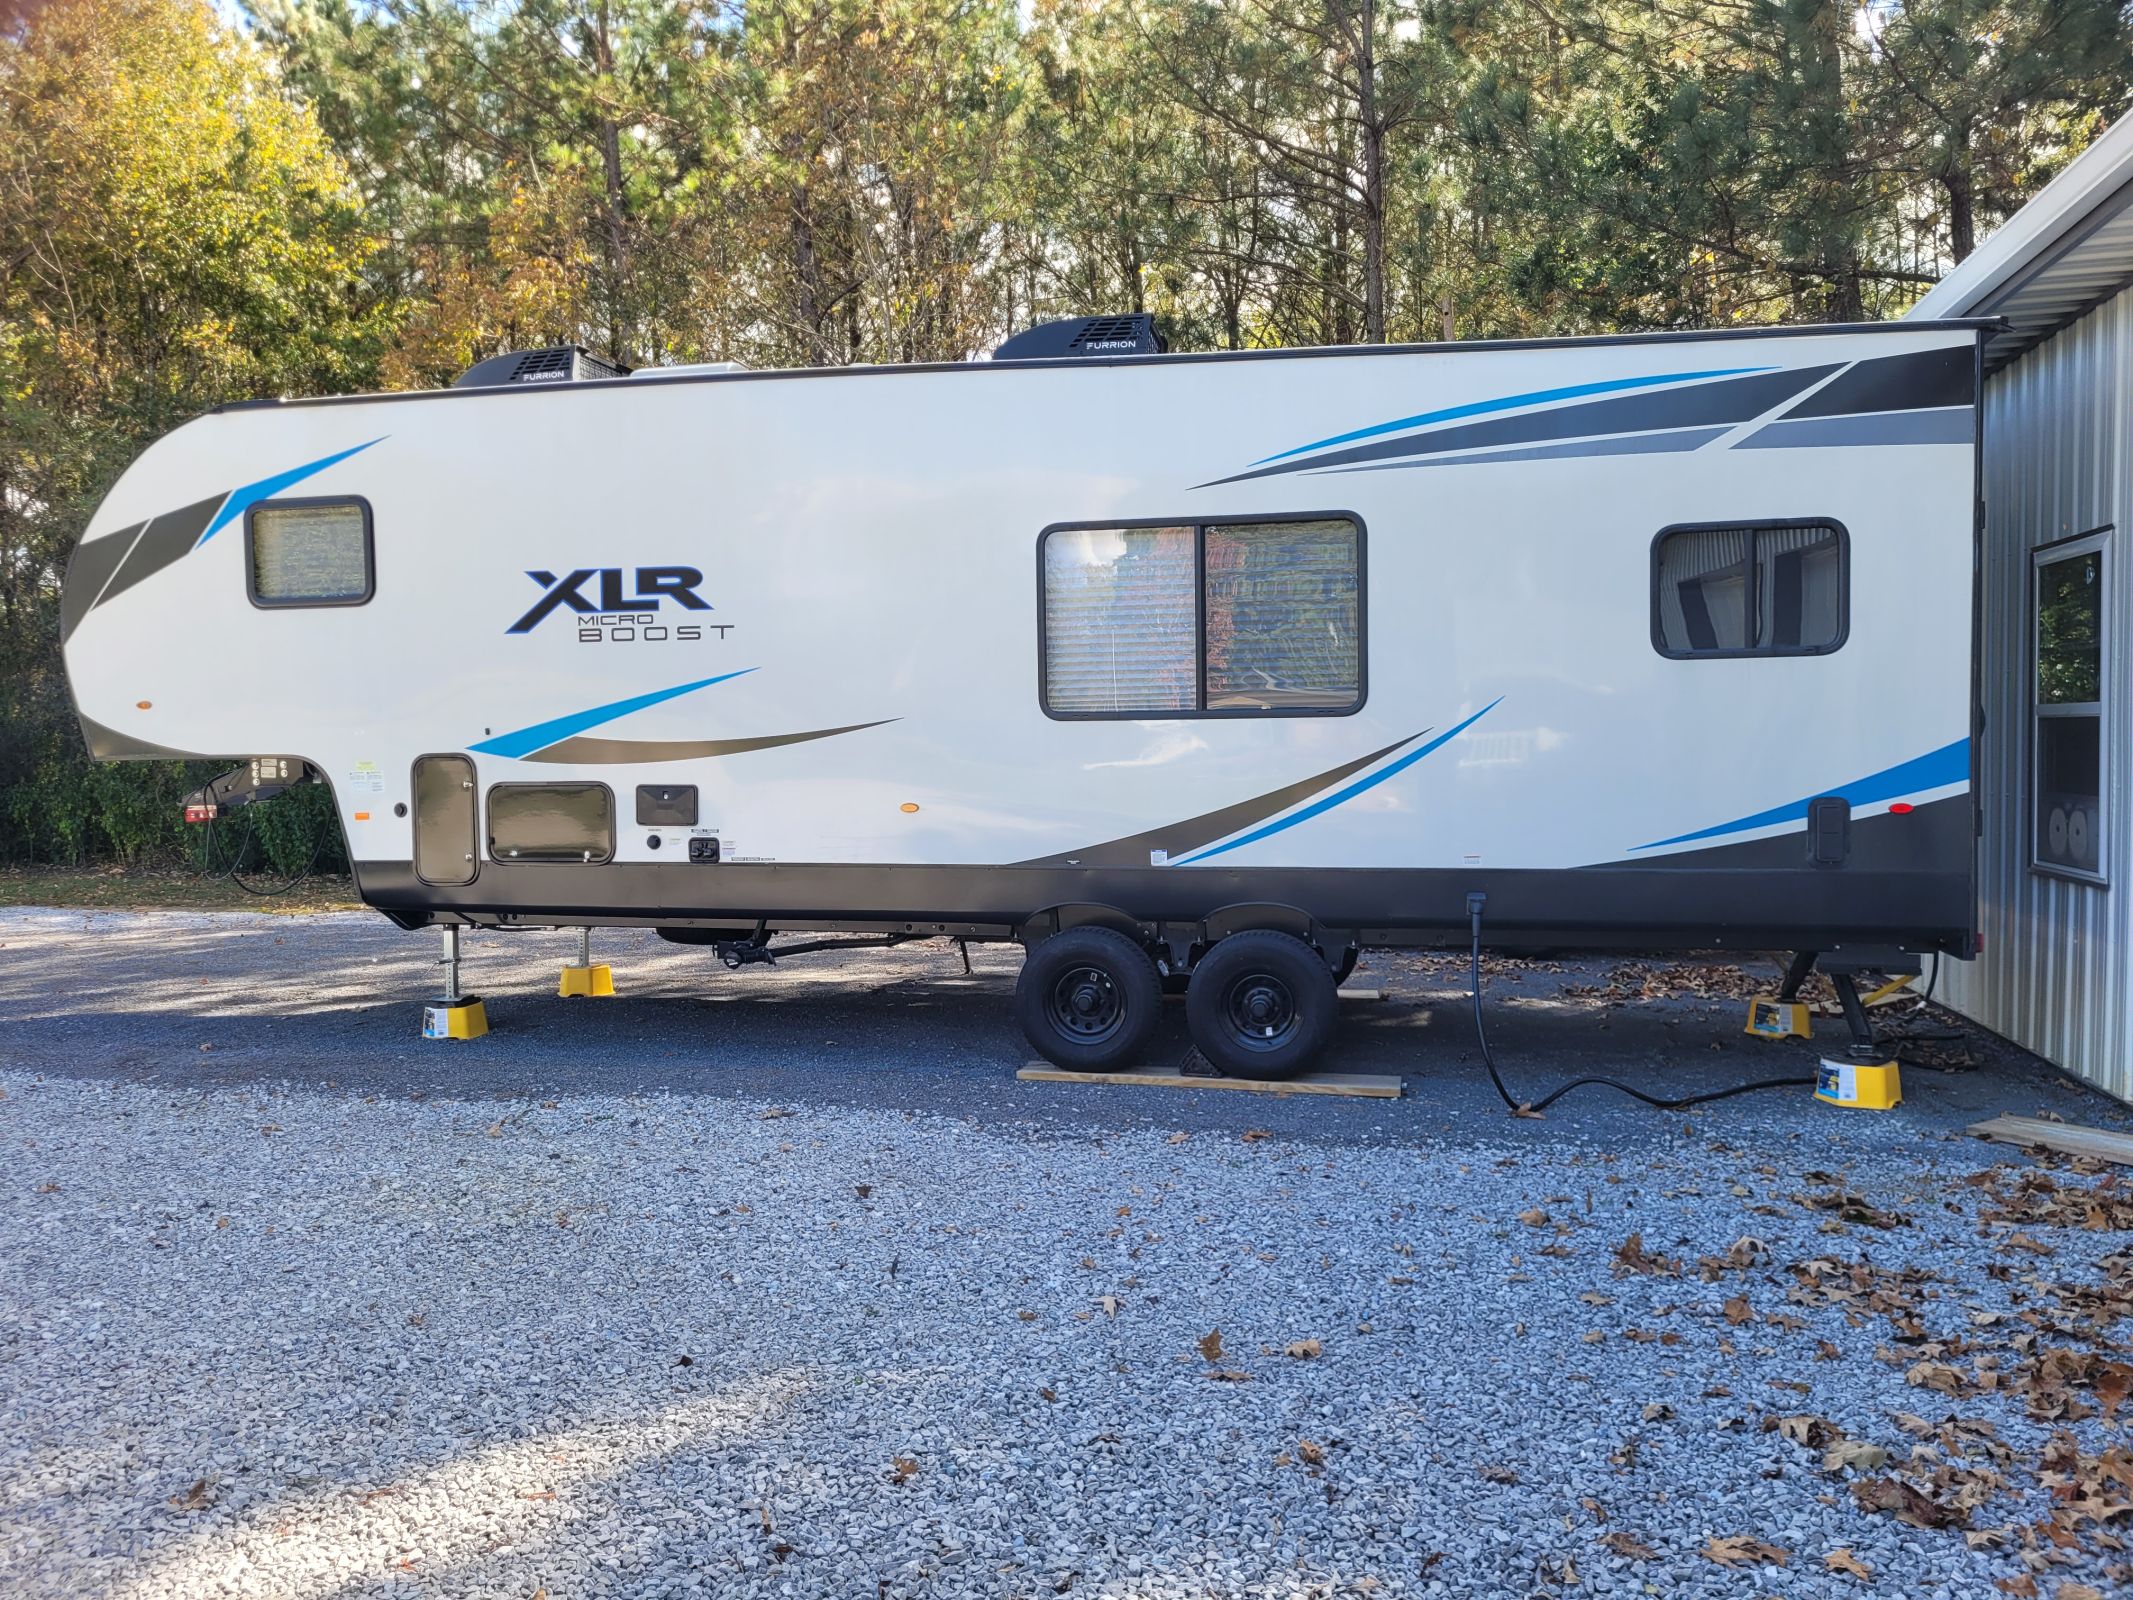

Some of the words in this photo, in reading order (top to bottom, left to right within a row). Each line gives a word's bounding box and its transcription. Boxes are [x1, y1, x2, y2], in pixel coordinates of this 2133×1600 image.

[1086, 341, 1136, 350] FURRION
[523, 371, 564, 381] FURRION
[504, 565, 715, 635] XLR
[578, 614, 653, 626] MICRO
[578, 625, 735, 642] BOOST
